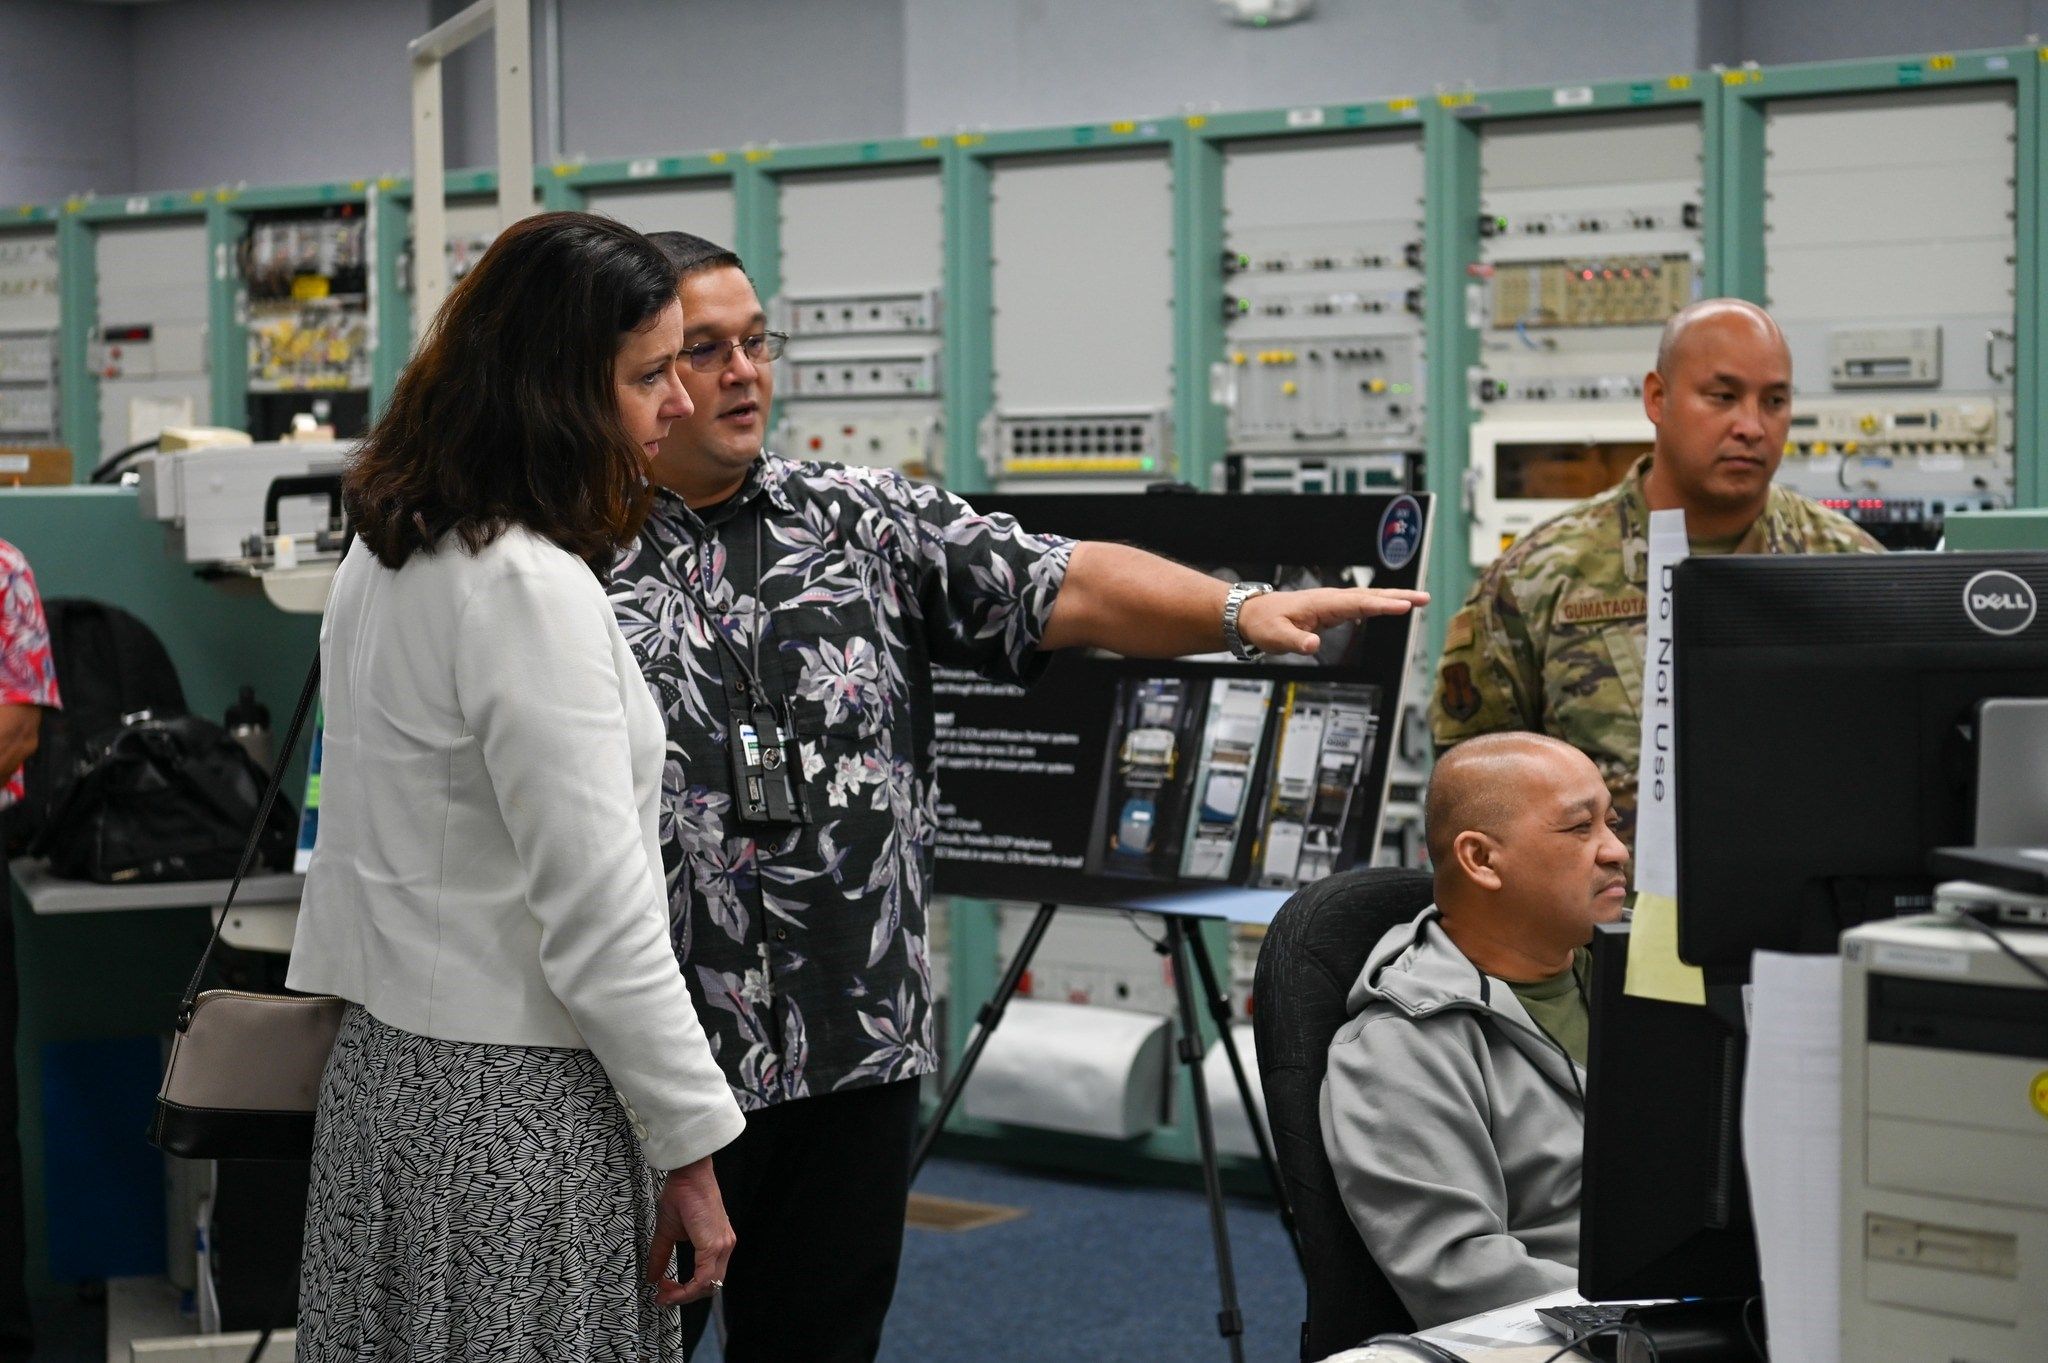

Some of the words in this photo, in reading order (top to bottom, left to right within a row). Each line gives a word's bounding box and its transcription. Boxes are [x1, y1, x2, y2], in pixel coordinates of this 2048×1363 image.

[1972, 592, 2030, 610] DELL
[1656, 638, 1672, 707] Not
[1654, 723, 1669, 802] Use
